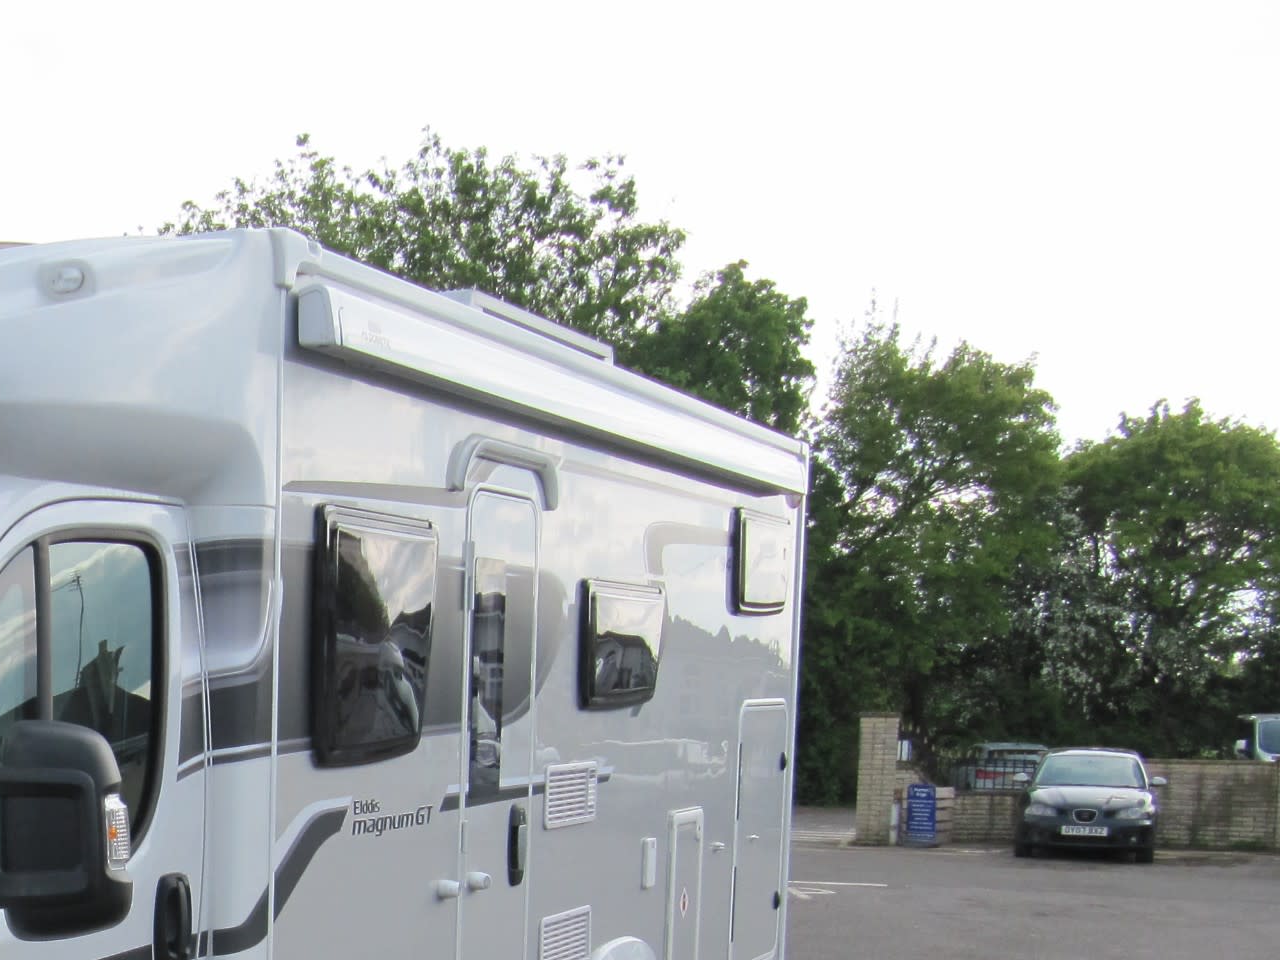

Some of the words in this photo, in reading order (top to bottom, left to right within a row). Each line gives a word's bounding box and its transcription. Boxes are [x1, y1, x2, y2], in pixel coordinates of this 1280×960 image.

[353, 800, 381, 816] Elddis
[351, 812, 415, 837] magnum
[415, 805, 433, 826] GT
